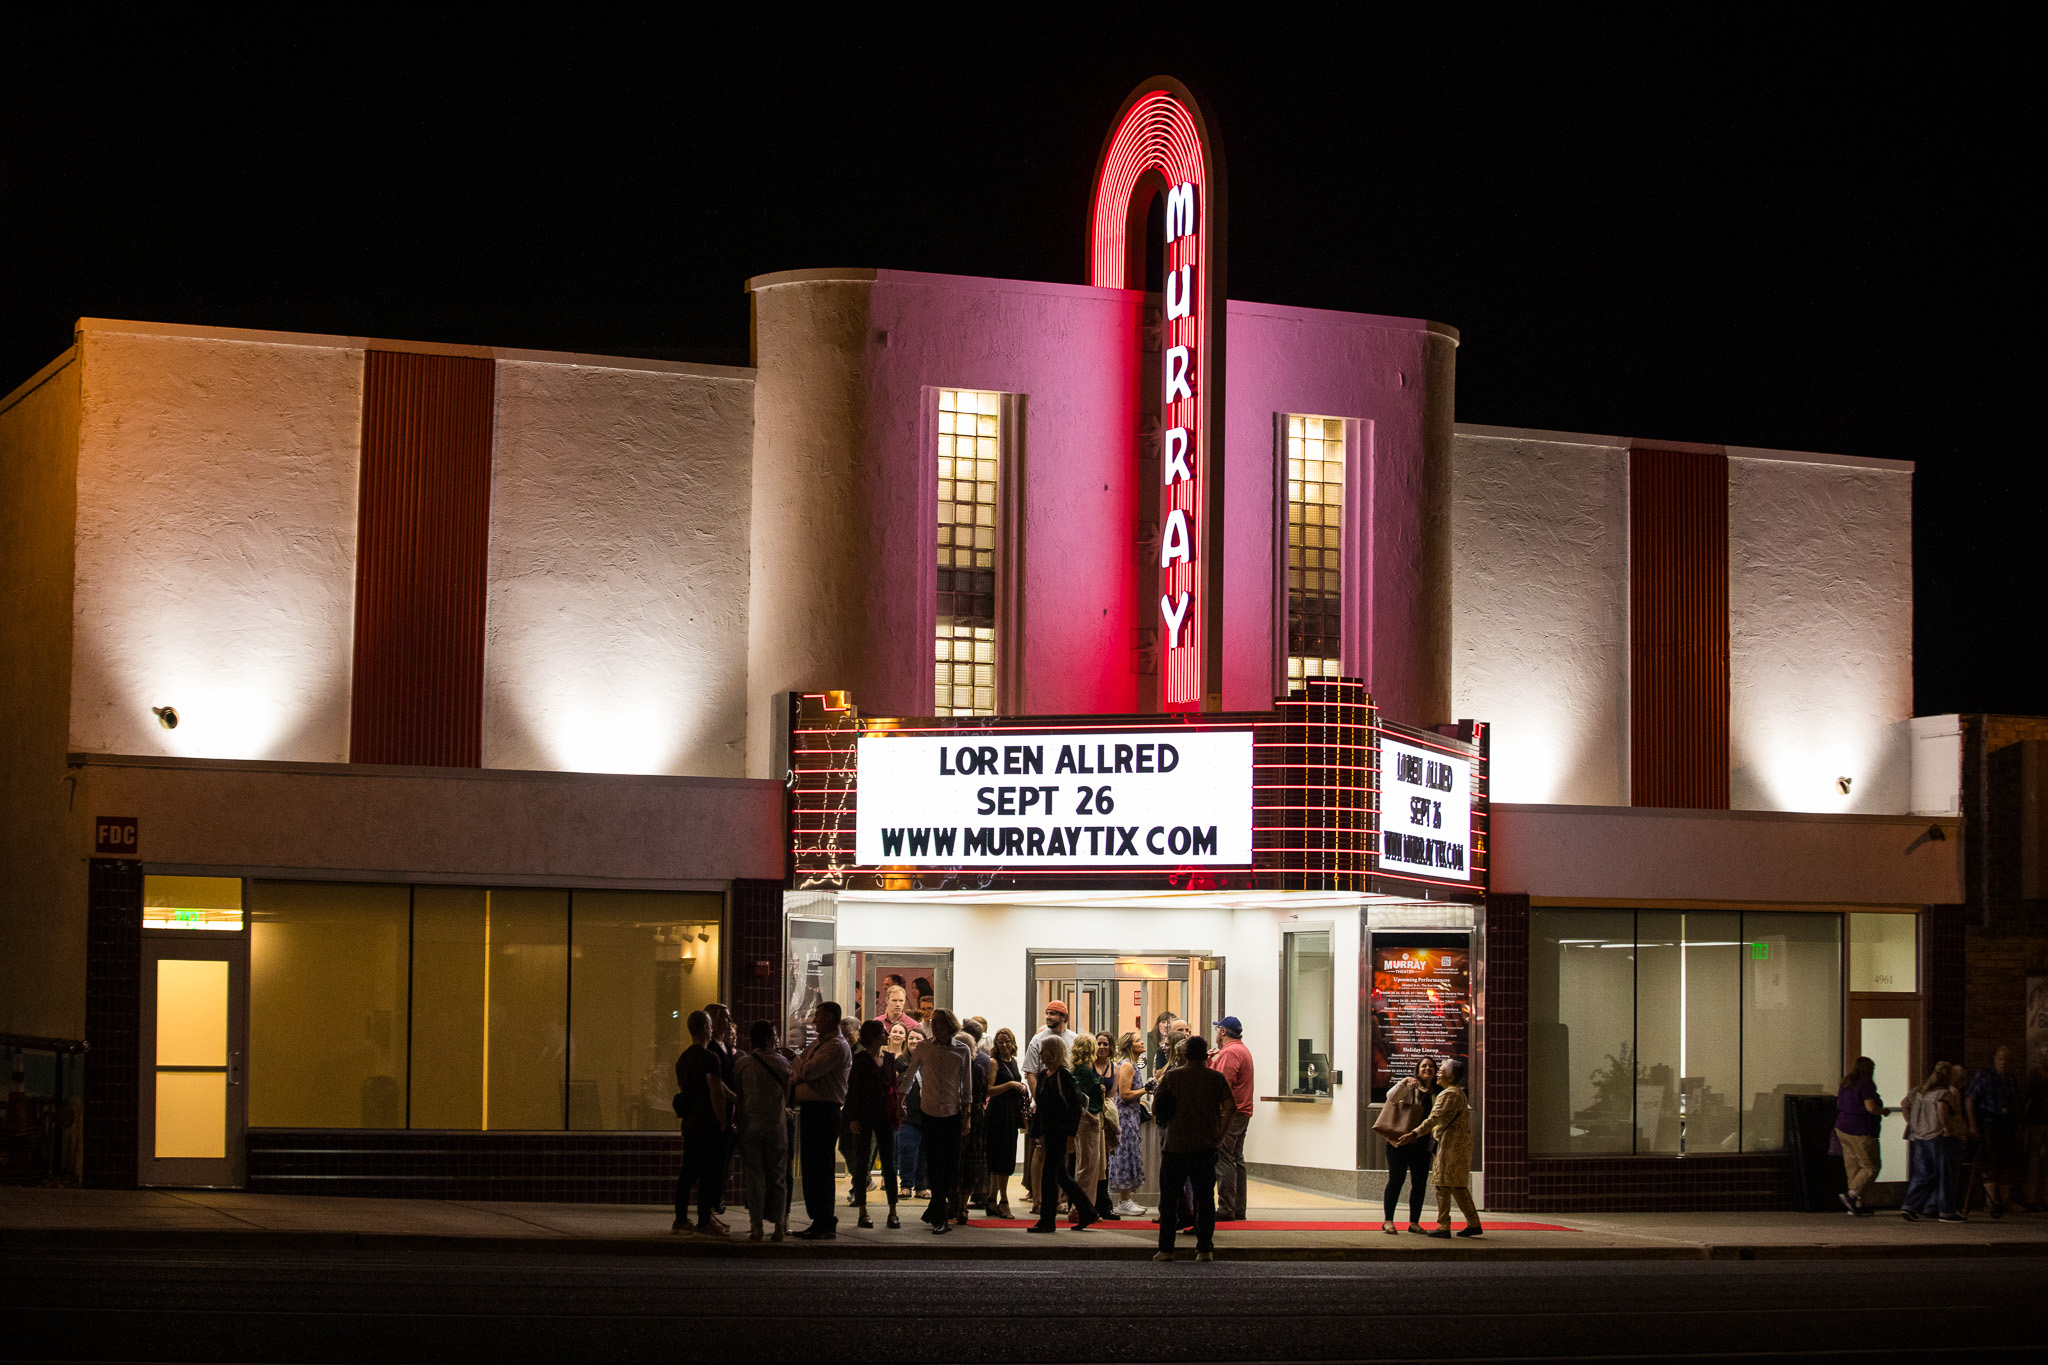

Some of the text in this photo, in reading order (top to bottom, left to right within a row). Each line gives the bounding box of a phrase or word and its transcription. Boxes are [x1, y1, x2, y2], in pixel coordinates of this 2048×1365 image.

[1160, 181, 1195, 649] MURRAY
[939, 743, 1180, 776] LOREN ALLRED
[976, 785, 1115, 816] SEPT 26
[98, 825, 135, 845] FDC
[1145, 826, 1218, 856] COM
[1383, 960, 1427, 971] MURRAY
